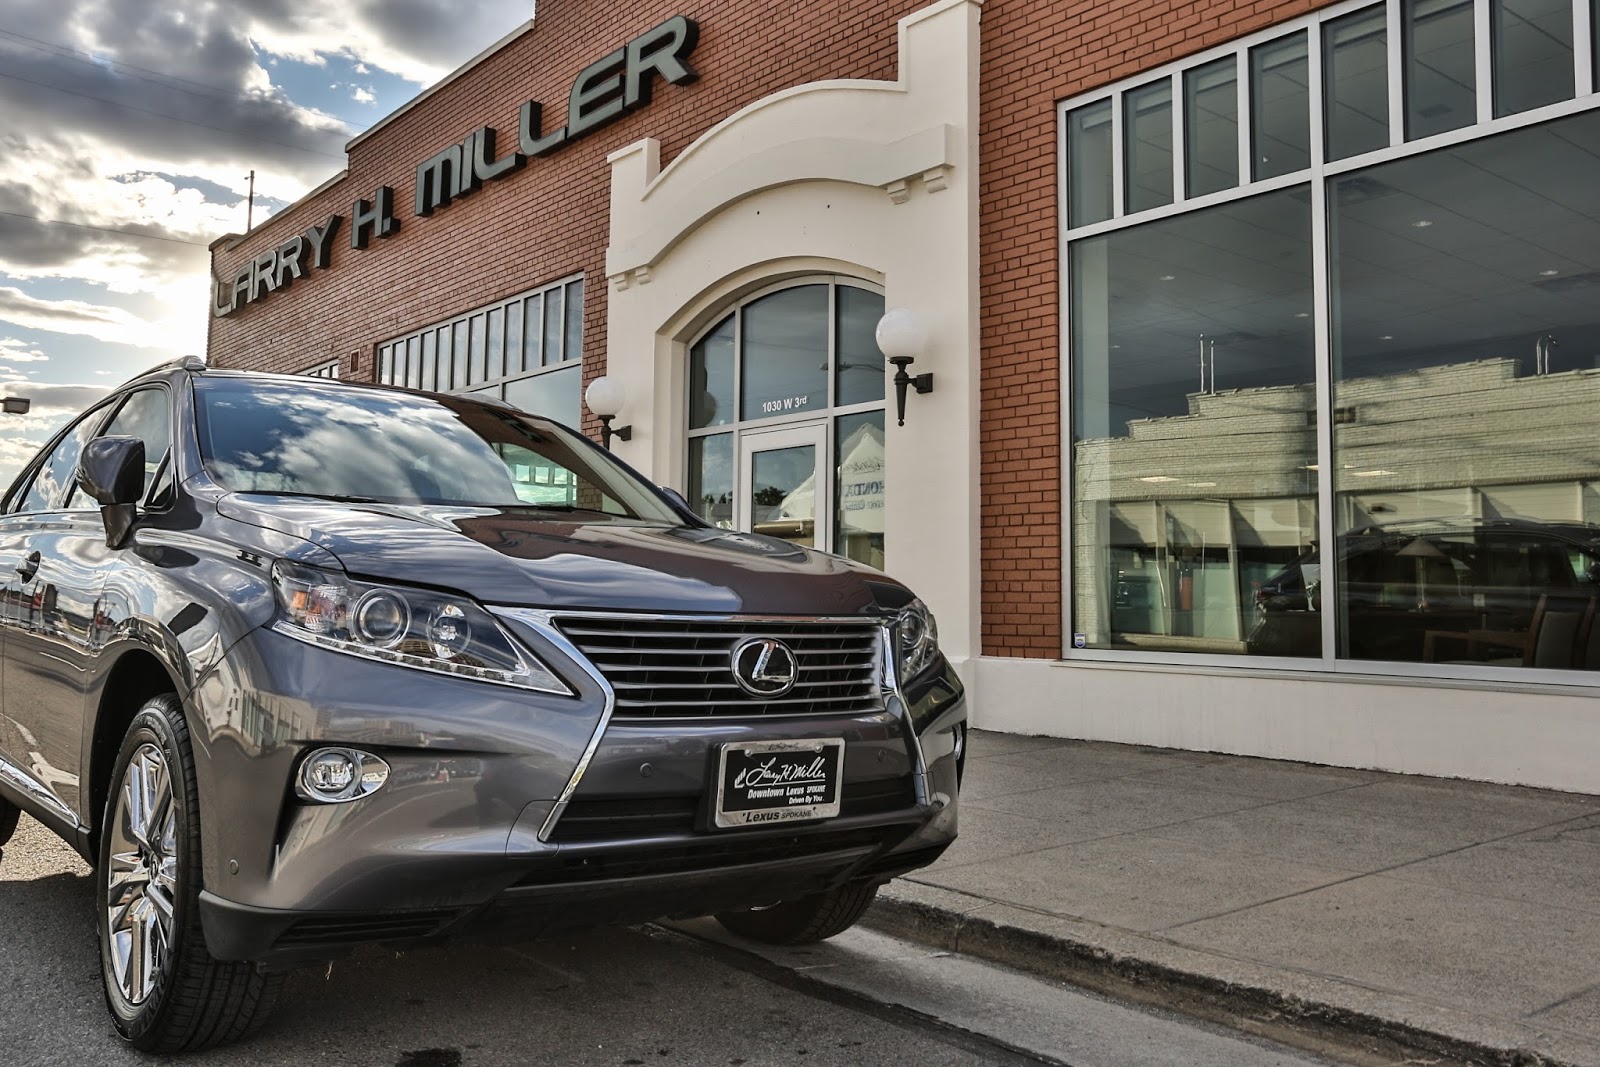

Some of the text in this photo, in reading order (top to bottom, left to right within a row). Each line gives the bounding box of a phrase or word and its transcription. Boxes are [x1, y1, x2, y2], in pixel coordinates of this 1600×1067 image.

[213, 214, 344, 318] LARRY
[415, 15, 699, 217] MILLER
[762, 395, 808, 413] 1030 W 3rd
[789, 756, 826, 781] Miller
[747, 785, 826, 799] Downtown Lexus SPOKANE
[788, 797, 805, 805] Driven
[805, 795, 813, 804] By
[745, 810, 812, 823] Lexus SPOKANE
